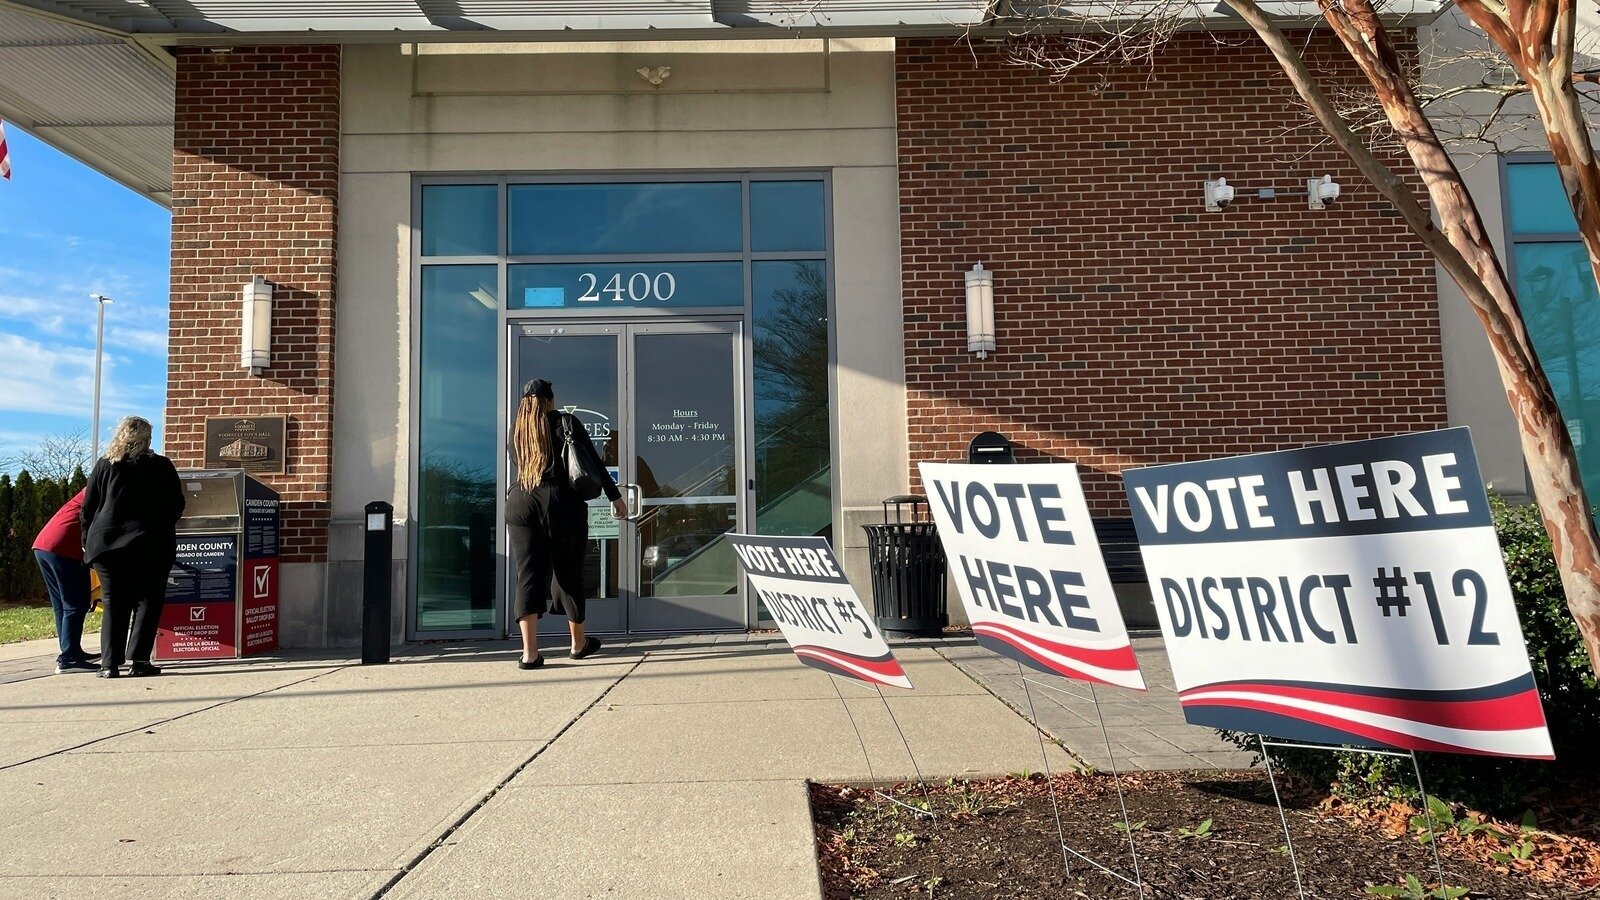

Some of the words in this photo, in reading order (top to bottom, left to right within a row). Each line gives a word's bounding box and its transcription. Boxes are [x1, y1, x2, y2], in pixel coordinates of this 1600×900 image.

[577, 272, 676, 301] 2400
[652, 422, 685, 431] Monday
[694, 421, 720, 430] Friday
[673, 409, 698, 417] Hours
[647, 434, 666, 442] 8:30
[668, 434, 683, 442] AM
[691, 433, 710, 441] 4:30
[712, 433, 725, 441] PM
[245, 499, 262, 507] CAMDEN
[262, 499, 278, 507] COUNTY
[1134, 474, 1276, 534] VOTE
[1287, 452, 1470, 526] HERE
[932, 479, 1076, 546] VOTE
[199, 542, 233, 550] COUNTY
[732, 543, 786, 574] VOTE
[778, 547, 841, 578] HERE
[959, 554, 1101, 633] HERE
[1160, 573, 1359, 645] DISTRICT
[1372, 566, 1501, 646] #12
[761, 589, 843, 635] DISTRICT
[832, 596, 873, 640] #5
